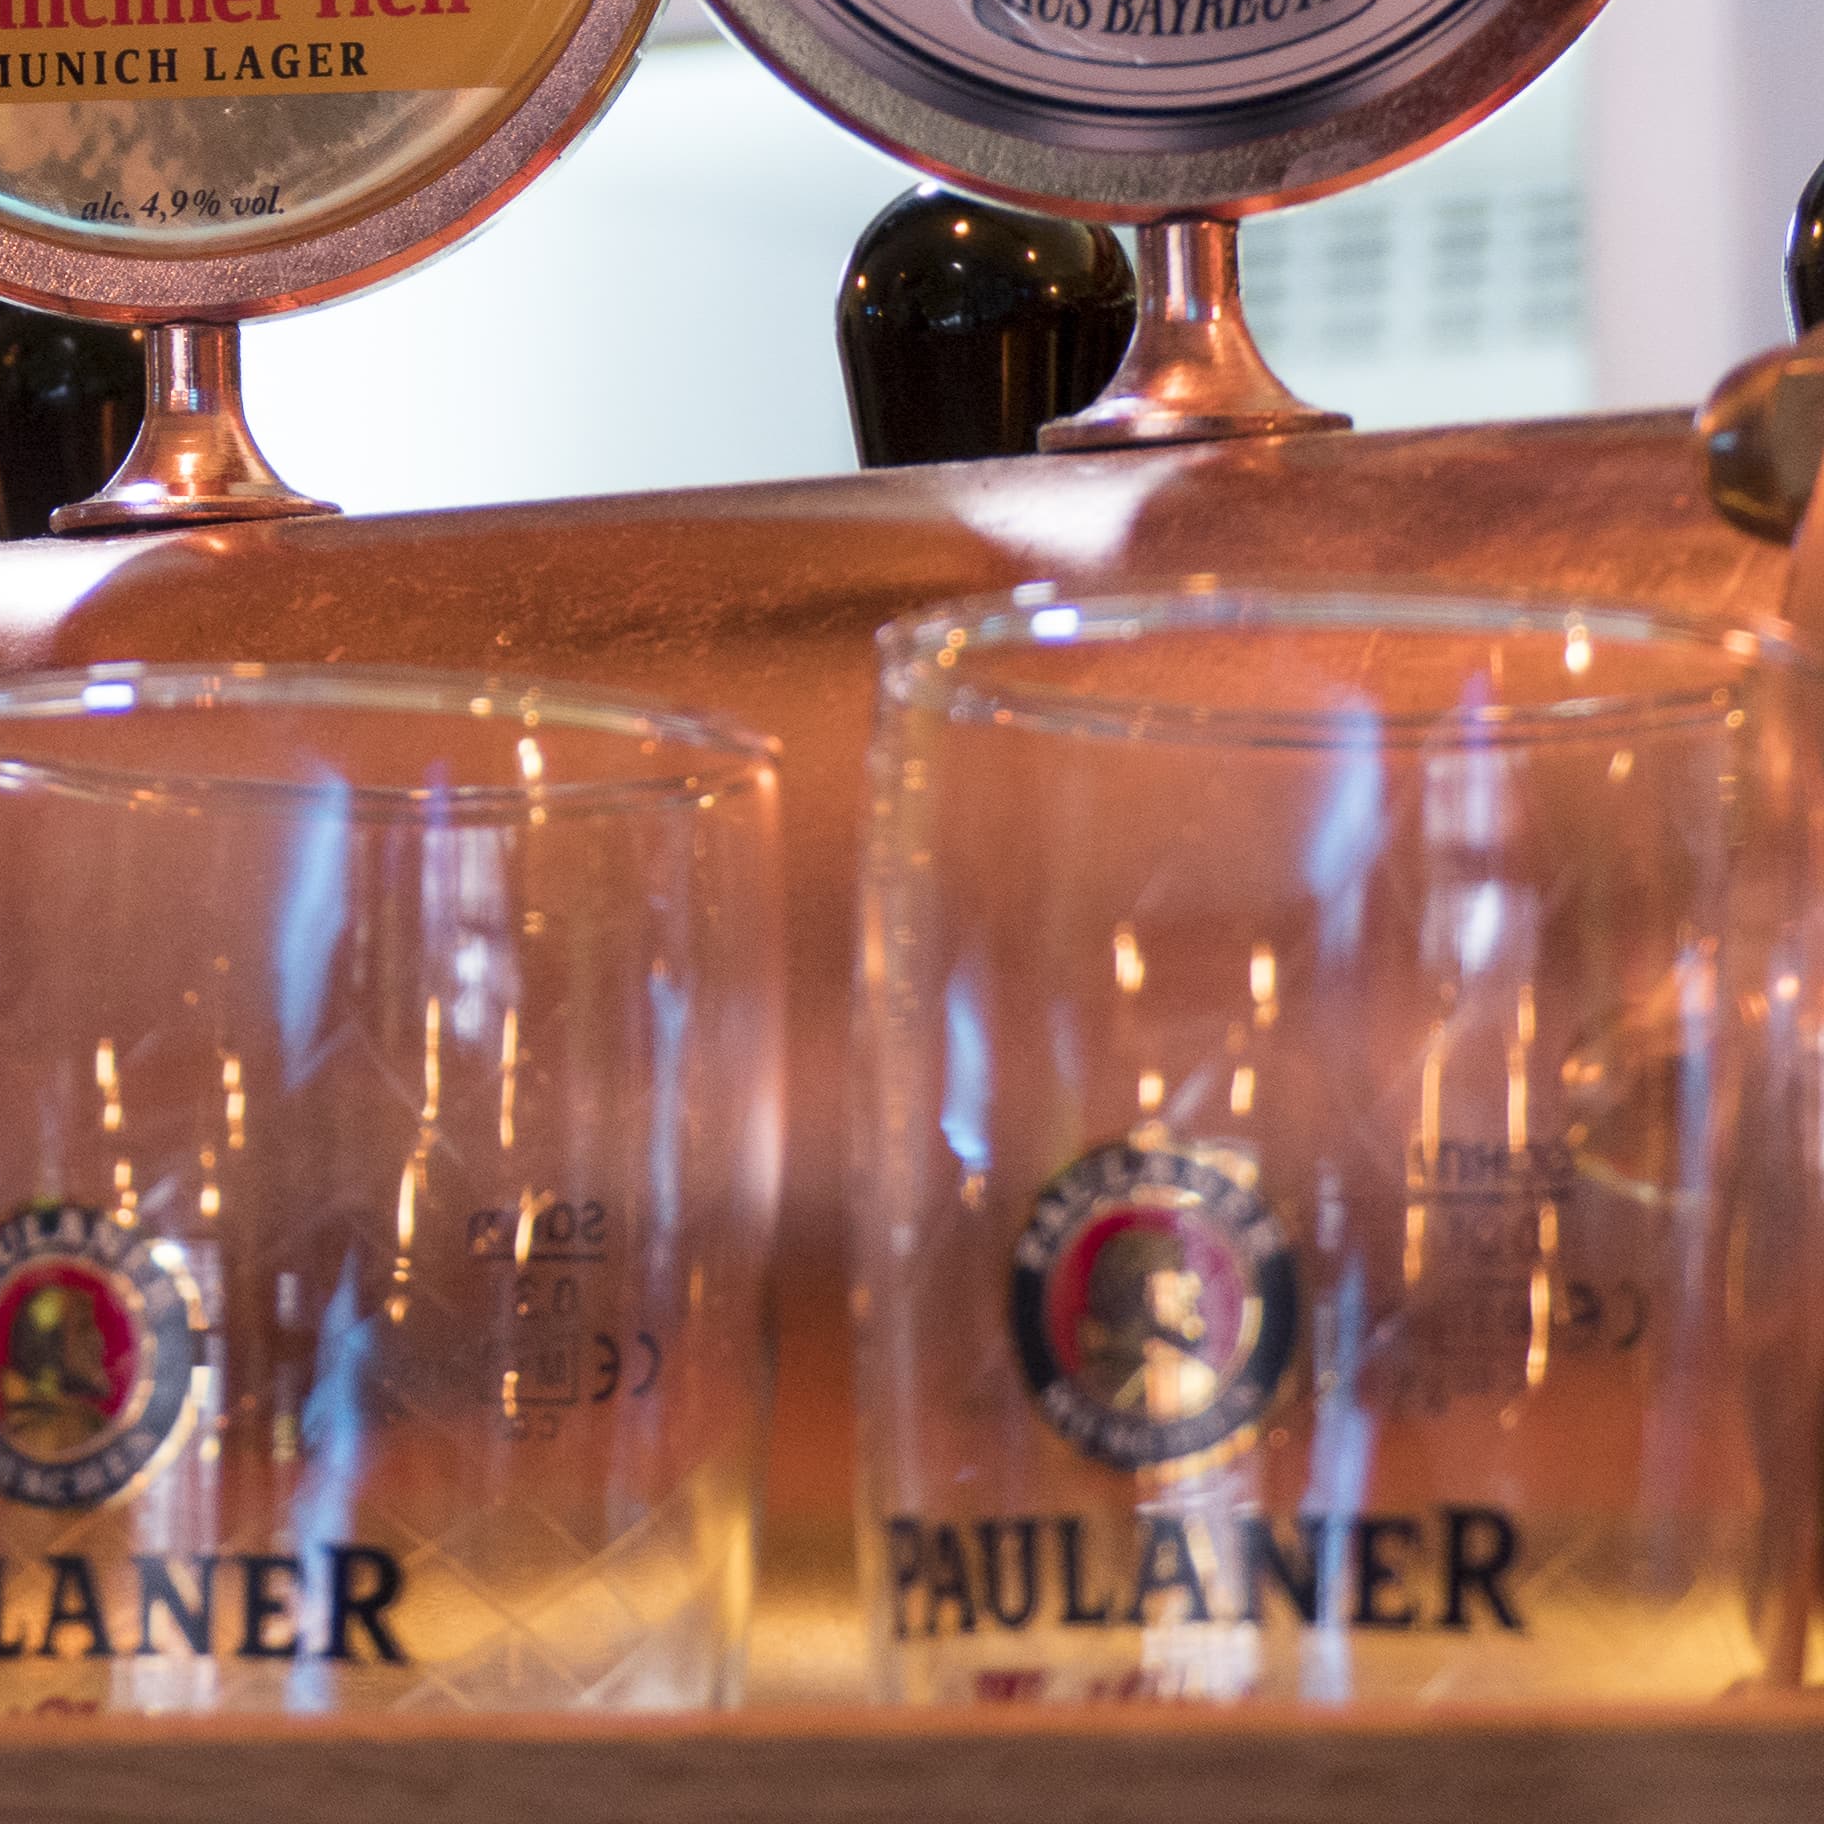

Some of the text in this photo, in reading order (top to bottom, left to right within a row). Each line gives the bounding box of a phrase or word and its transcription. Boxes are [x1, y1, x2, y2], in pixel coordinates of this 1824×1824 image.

[204, 41, 369, 83] LAGER
[81, 186, 286, 224] alc. 4,9% vol.
